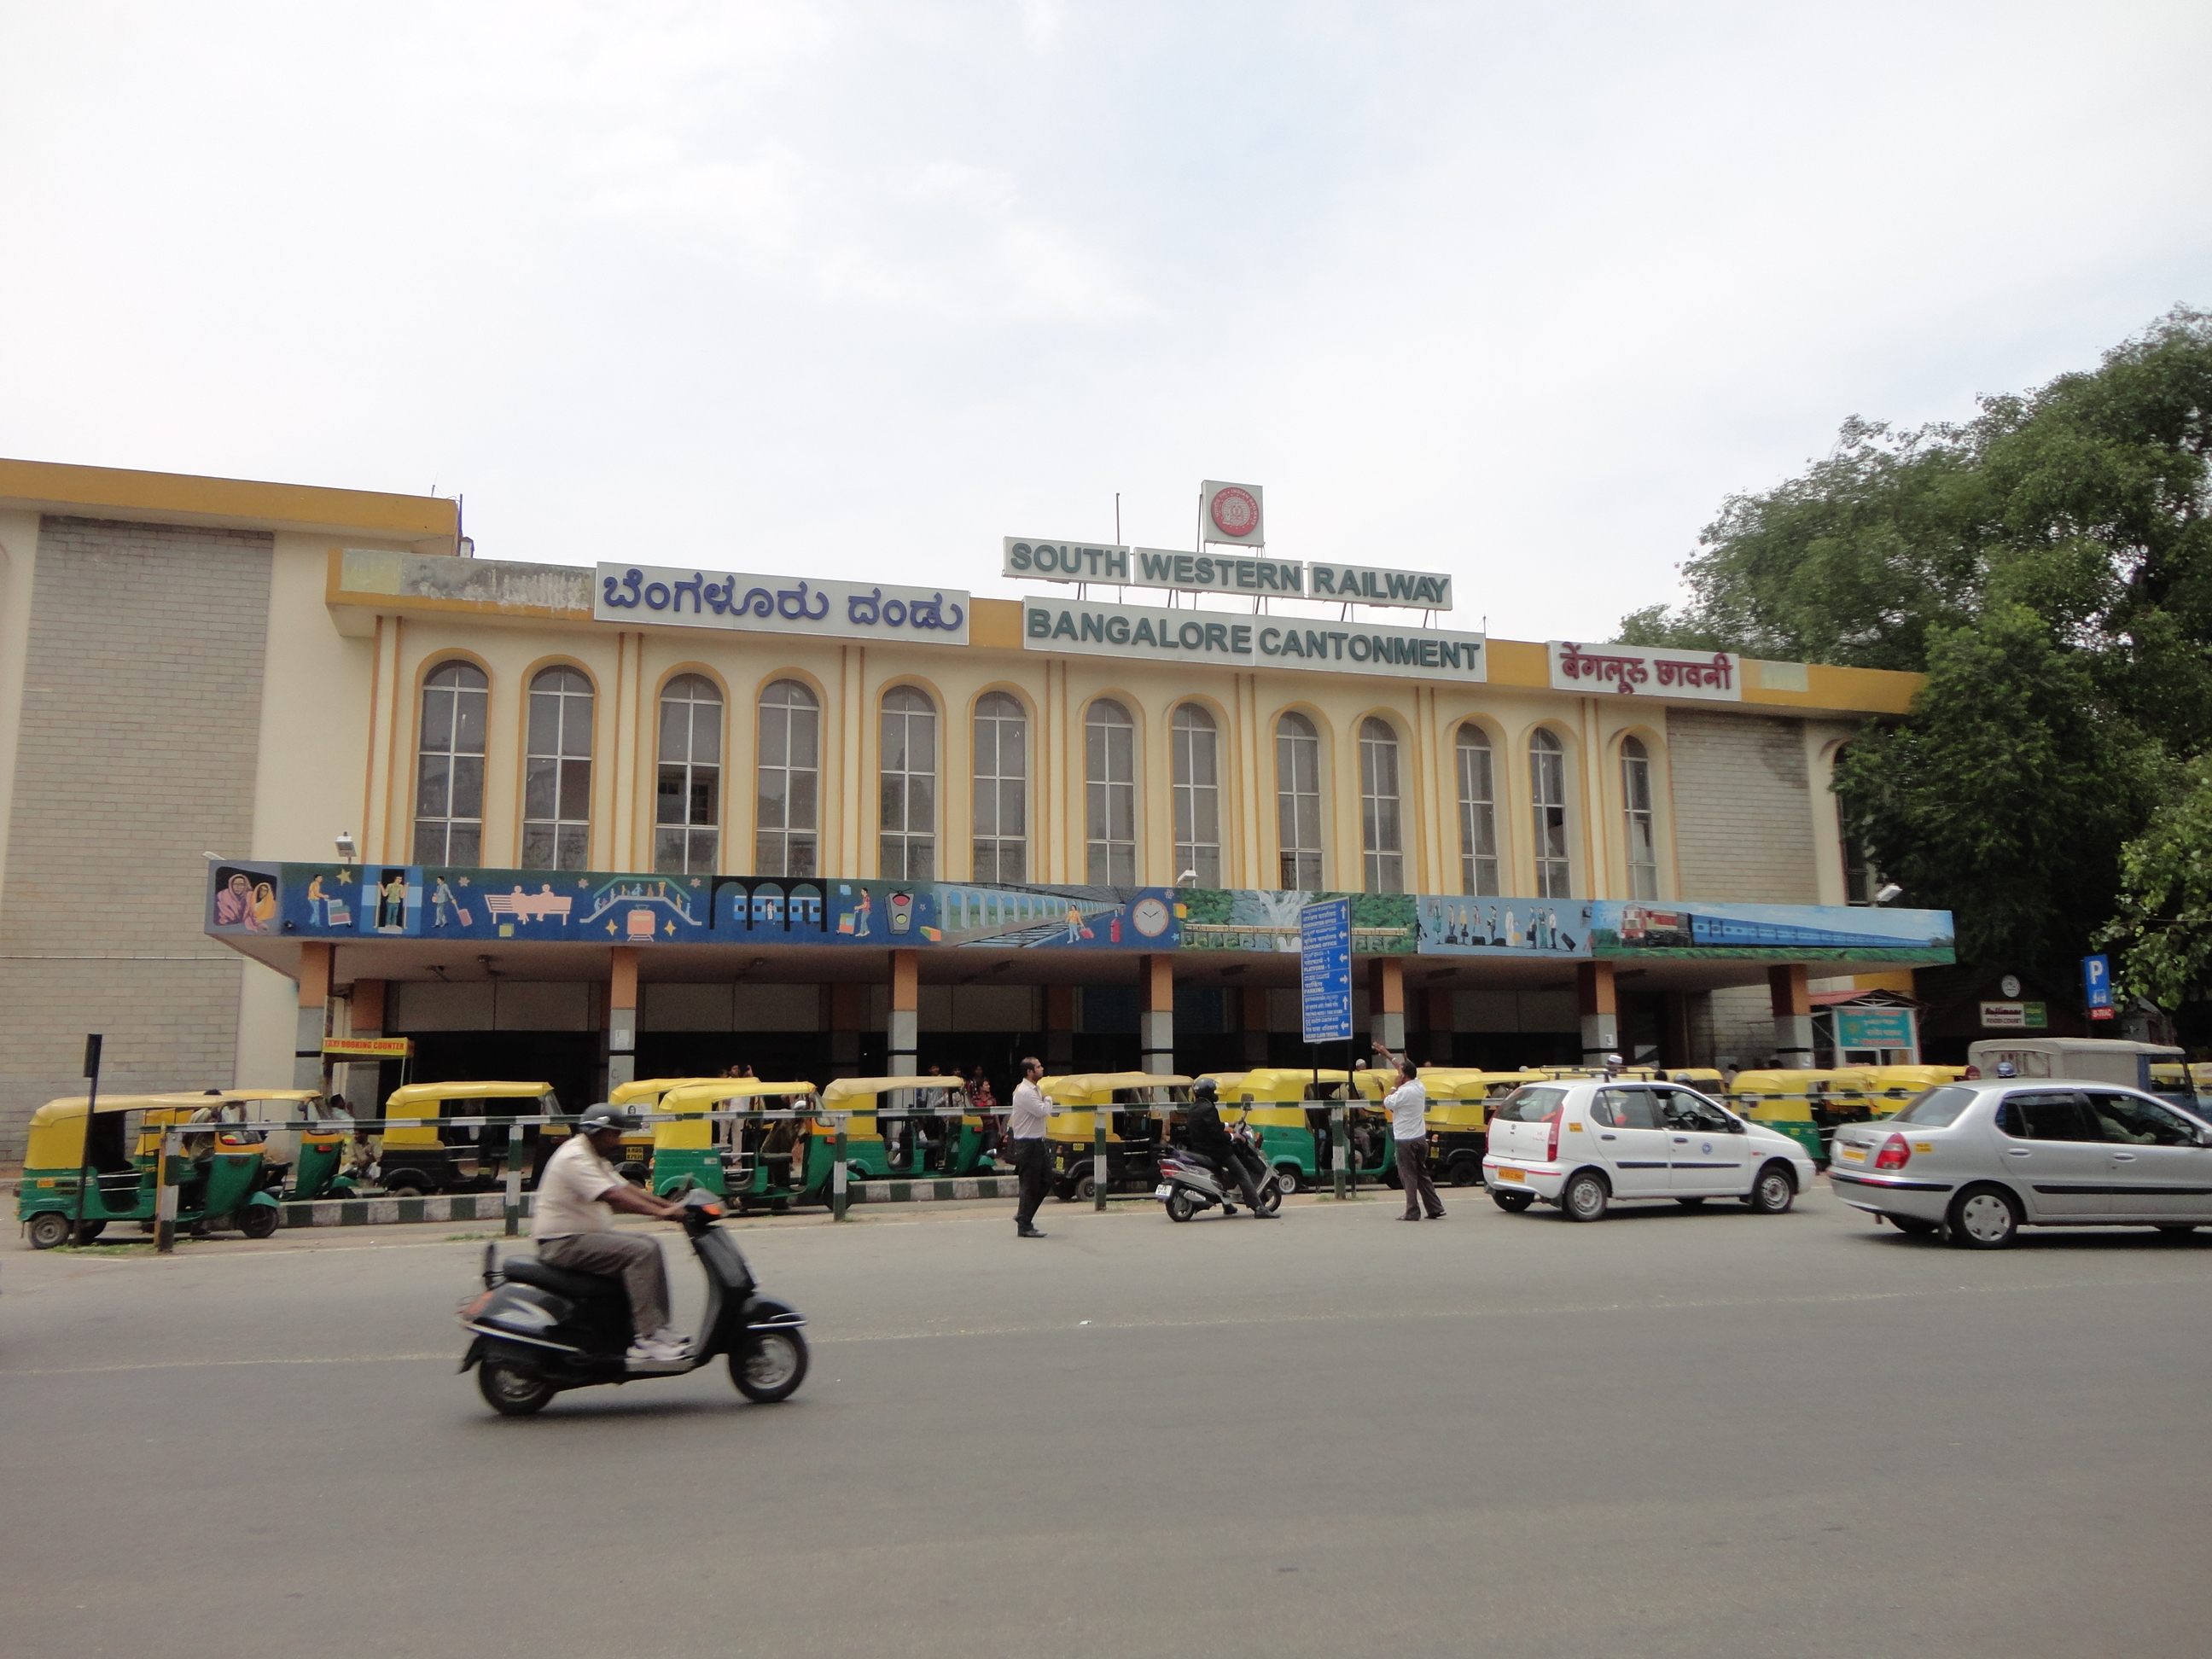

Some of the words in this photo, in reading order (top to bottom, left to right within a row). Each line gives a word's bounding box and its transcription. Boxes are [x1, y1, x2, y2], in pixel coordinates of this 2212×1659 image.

[1231, 489, 1249, 499] INDIAN
[1249, 497, 1259, 526] RAILWAYS
[1010, 543, 1127, 578] SOUTH
[1140, 553, 1302, 592] WESTERN
[1313, 567, 1449, 603] RAILWAY
[603, 568, 830, 620] ಬೆಂಗಳೂರು
[848, 586, 963, 631] ದಂಡು
[1027, 608, 1252, 654] BANGALORE
[1259, 627, 1481, 670] CANTONMENT
[1654, 652, 1733, 690] छावनी
[2088, 960, 2103, 985] P
[341, 1040, 372, 1049] BOOKING
[373, 1042, 404, 1051] COUNTER
